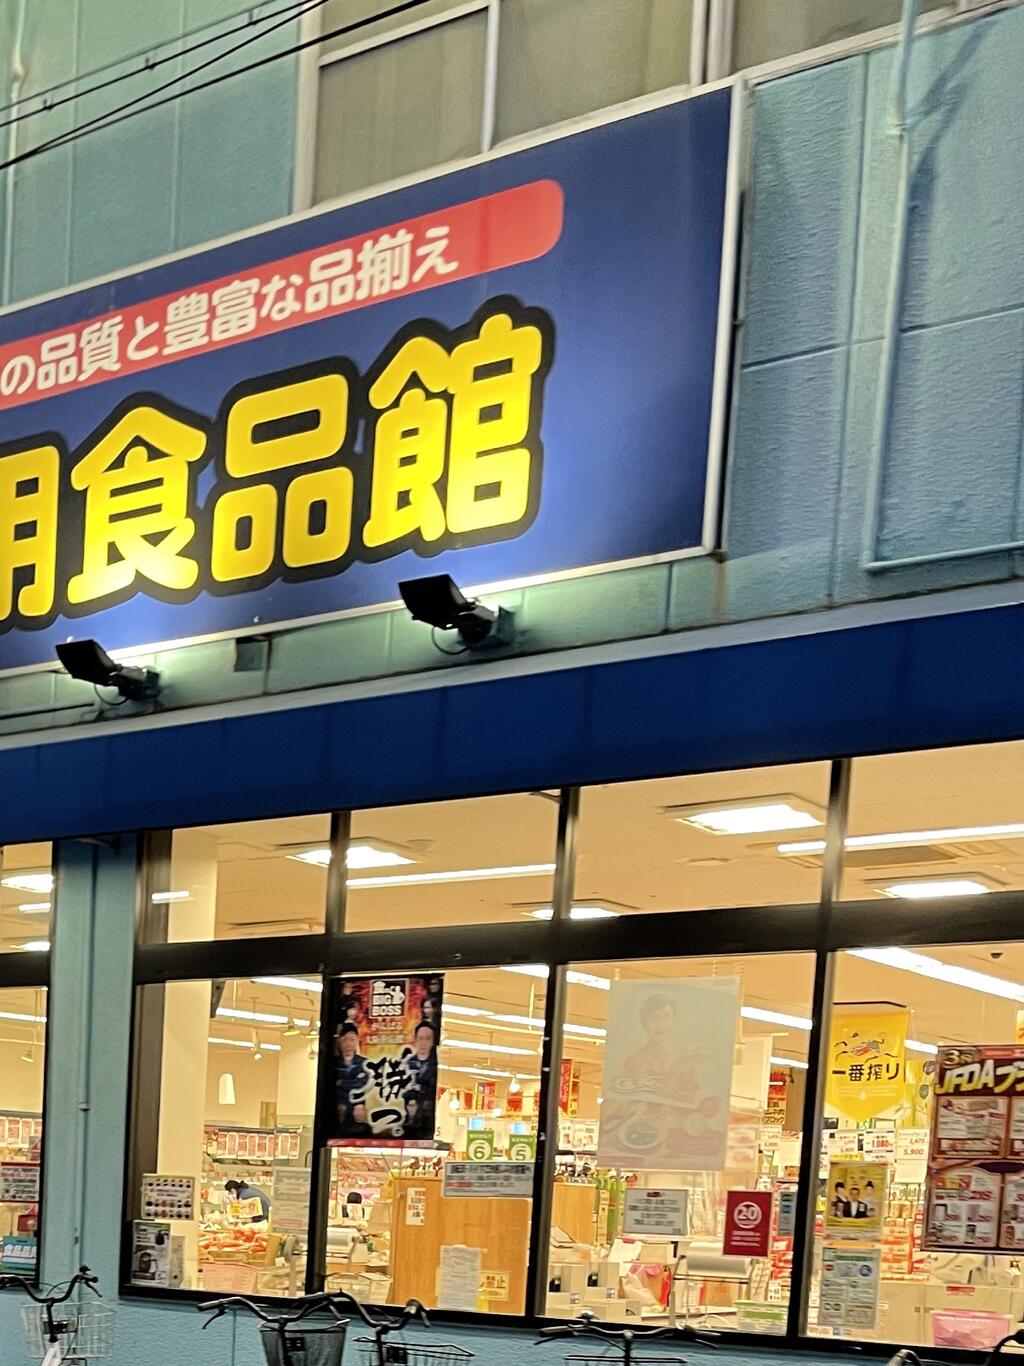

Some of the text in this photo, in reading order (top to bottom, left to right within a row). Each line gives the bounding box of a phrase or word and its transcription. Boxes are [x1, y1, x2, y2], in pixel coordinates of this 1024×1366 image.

[372, 1005, 402, 1016] BOSS
[832, 1063, 900, 1081] 一番搾り
[474, 1146, 485, 1160] 6
[738, 1206, 758, 1220] 20
